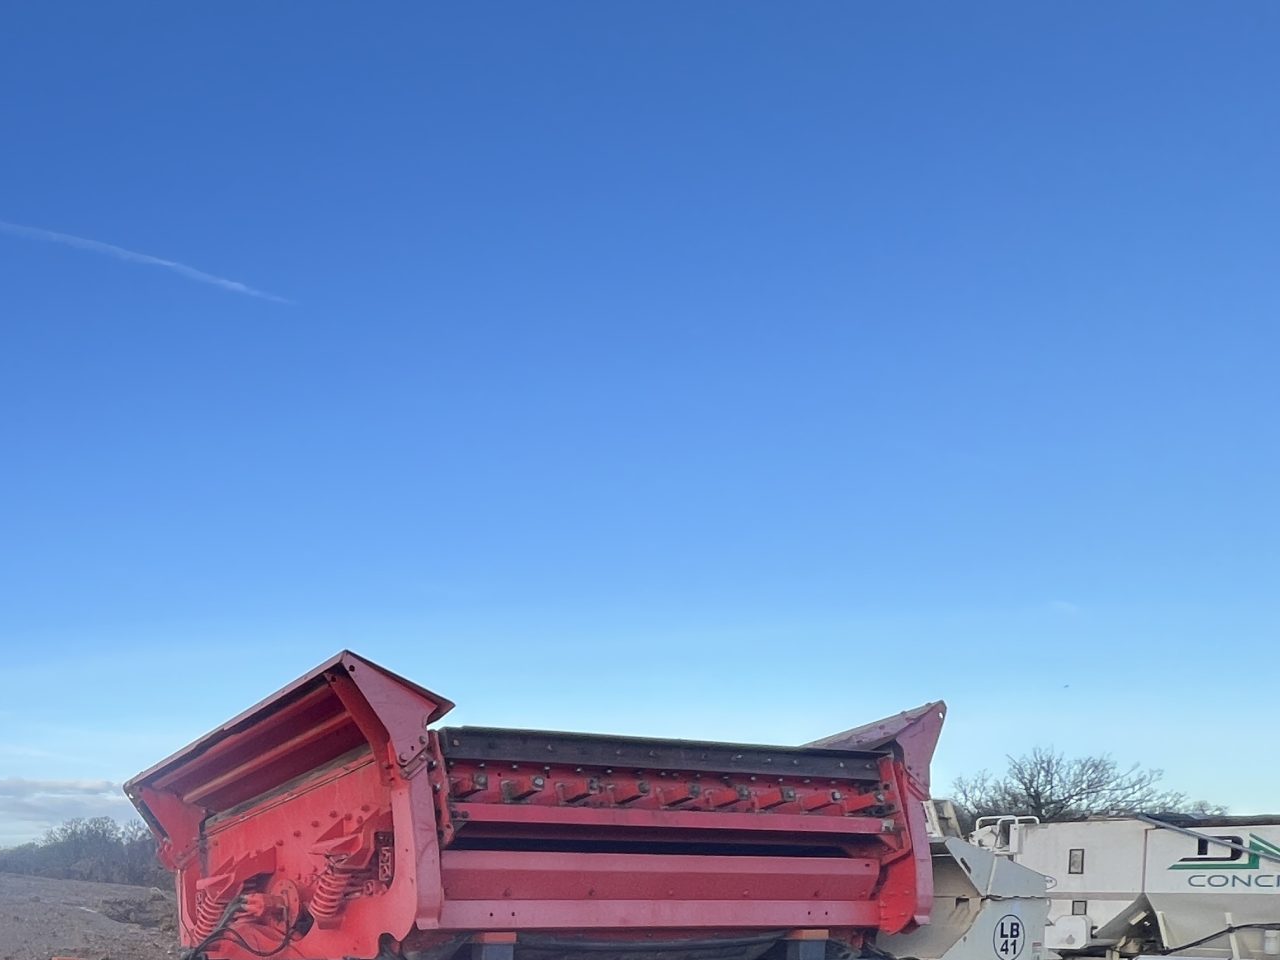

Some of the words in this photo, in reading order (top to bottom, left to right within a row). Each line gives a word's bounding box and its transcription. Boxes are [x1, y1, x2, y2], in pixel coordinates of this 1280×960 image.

[1188, 874, 1280, 888] CONC
[1000, 921, 1020, 939] LB
[1000, 939, 1017, 955] 41
